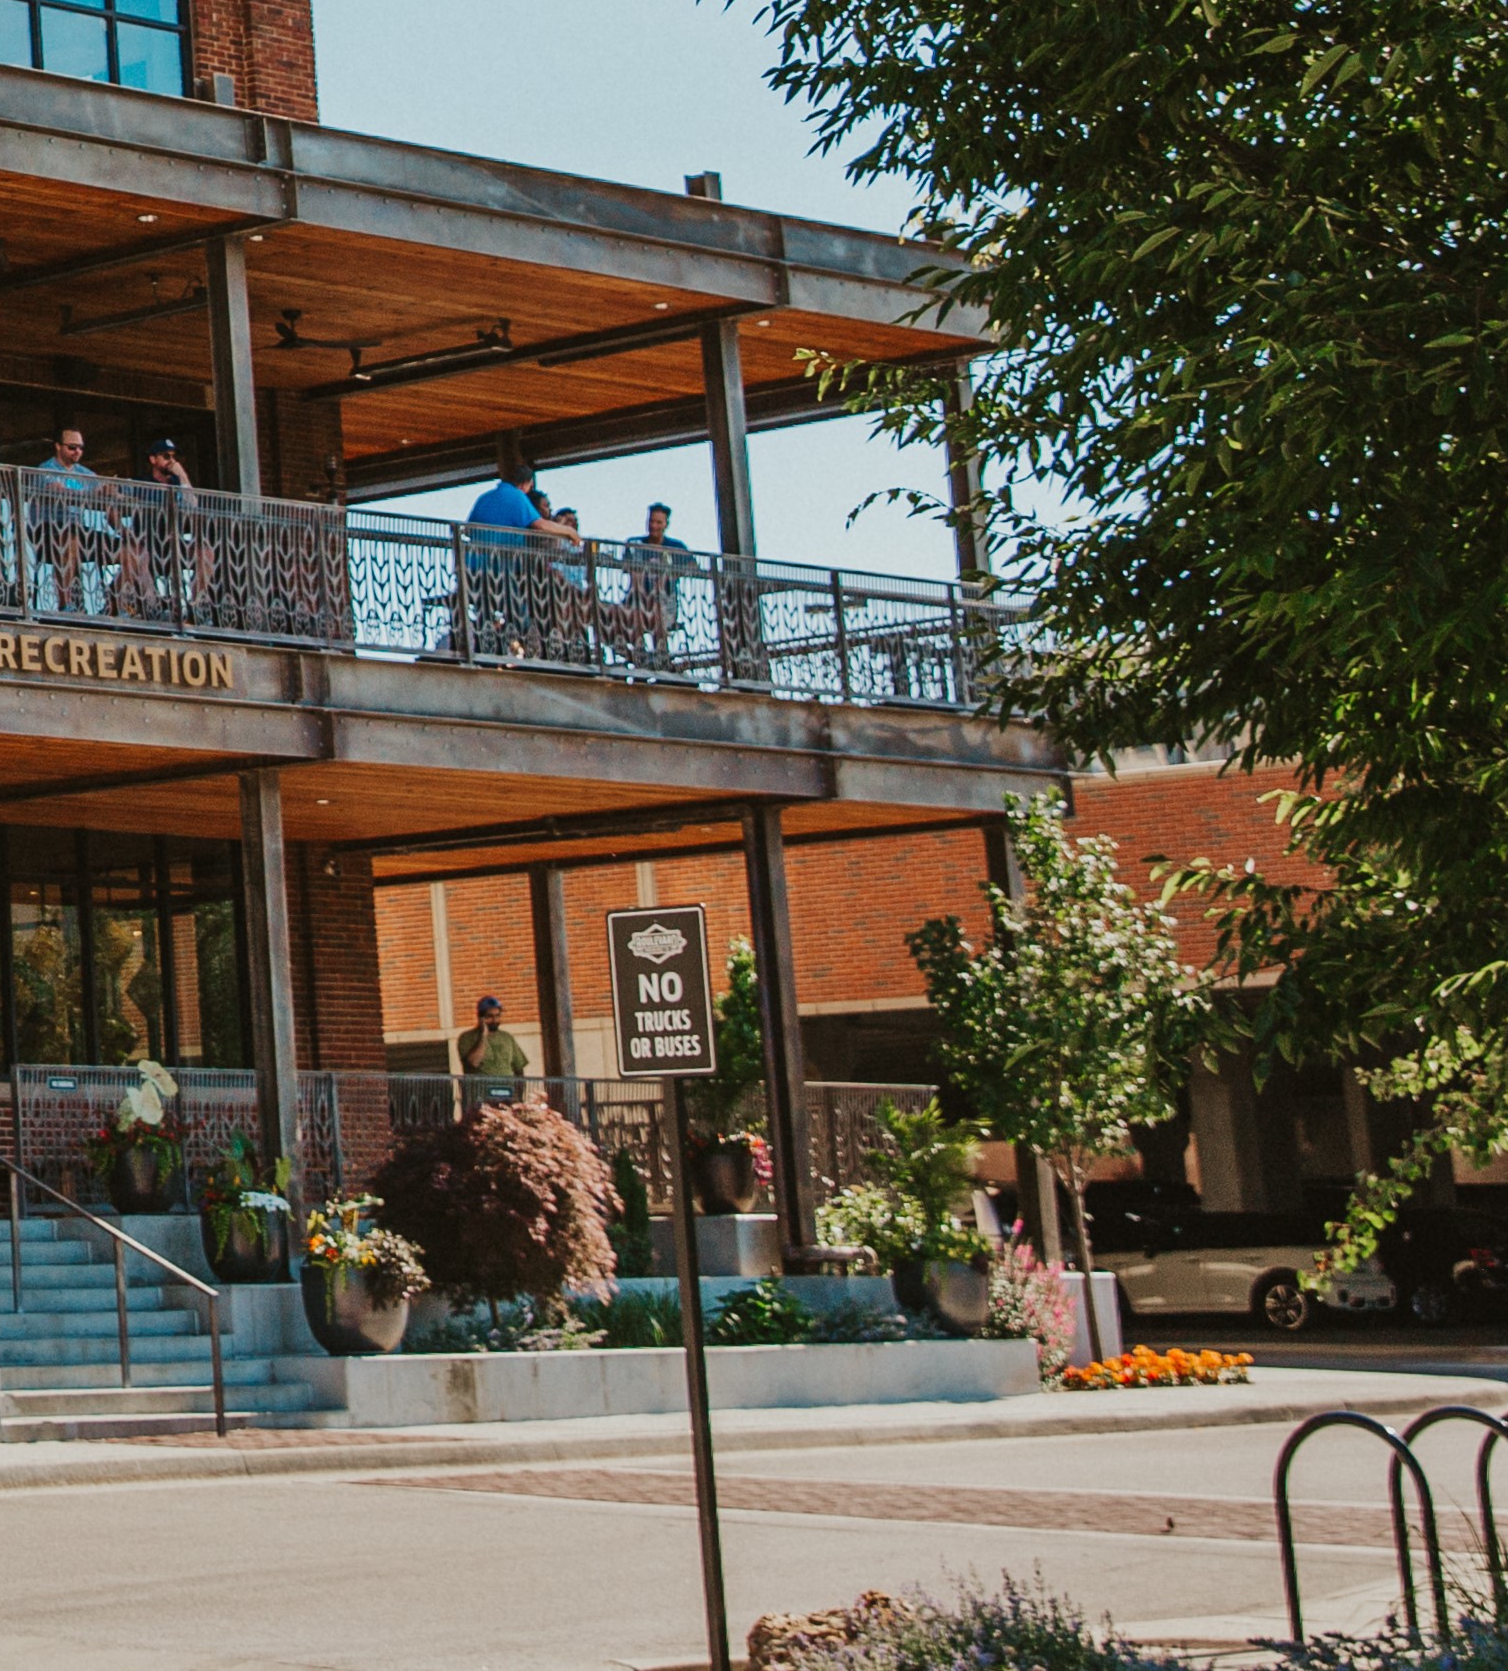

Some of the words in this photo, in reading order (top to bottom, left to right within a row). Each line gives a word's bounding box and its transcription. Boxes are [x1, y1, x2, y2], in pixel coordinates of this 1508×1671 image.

[637, 971, 683, 1004] NO
[635, 1009, 692, 1033] TRUCKS
[630, 1037, 652, 1059] OR
[655, 1035, 702, 1058] BUSES
